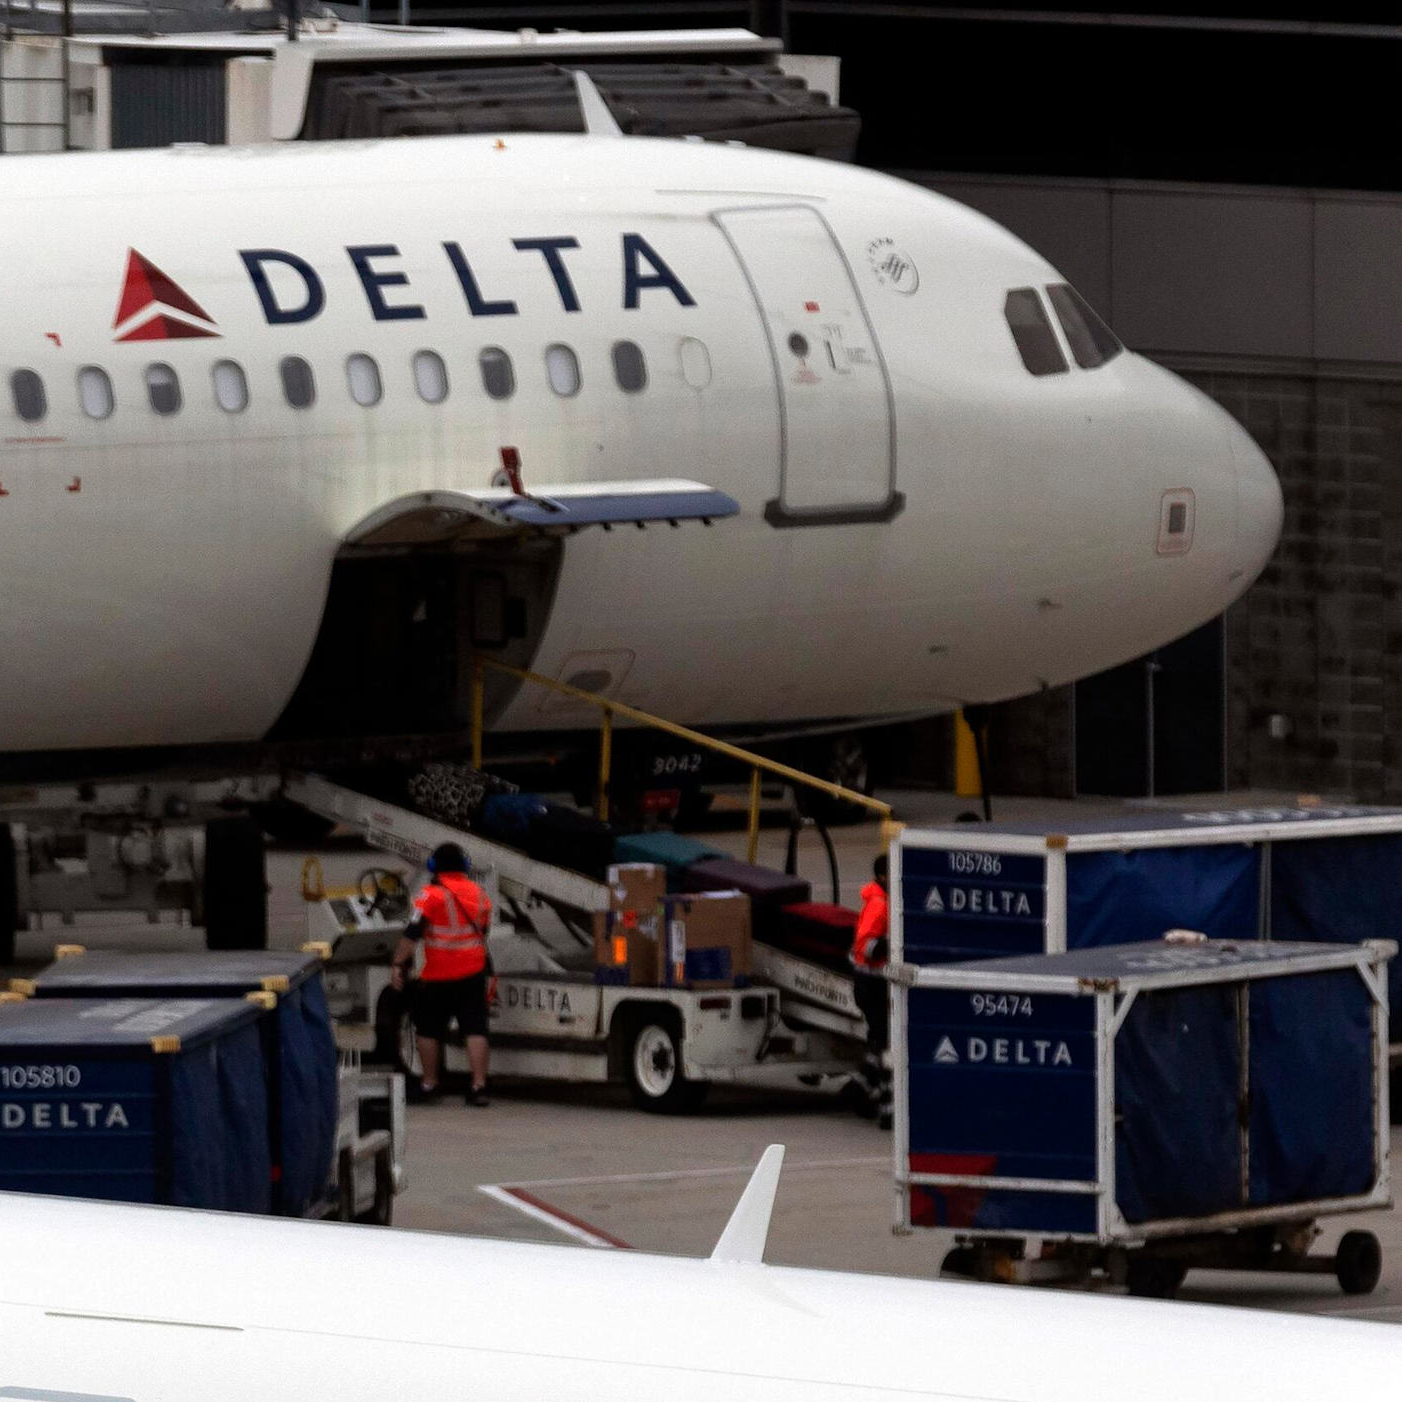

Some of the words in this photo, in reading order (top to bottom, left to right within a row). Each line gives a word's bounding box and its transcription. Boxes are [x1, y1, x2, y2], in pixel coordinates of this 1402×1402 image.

[237, 231, 699, 326] DELTA
[948, 851, 1002, 876] 105786
[951, 887, 1031, 915] DELTA
[506, 983, 572, 1012] DELTA
[970, 993, 1033, 1017] 95474
[967, 1036, 1072, 1066] DELTA
[0, 1063, 82, 1089] 105810
[1, 1102, 130, 1129] DELTA
